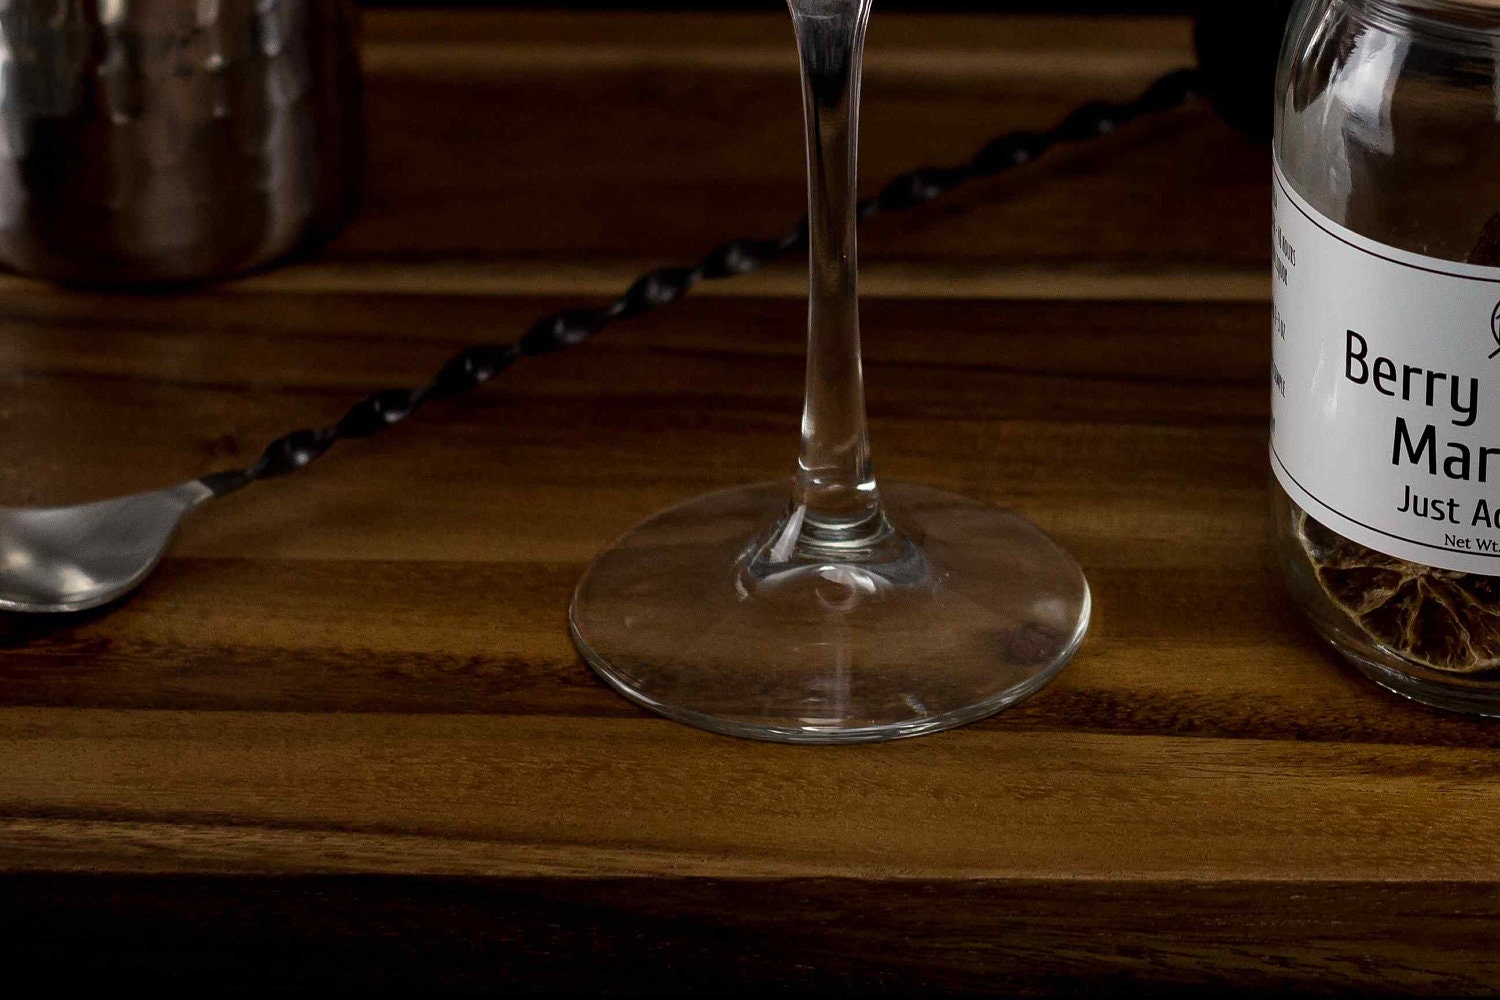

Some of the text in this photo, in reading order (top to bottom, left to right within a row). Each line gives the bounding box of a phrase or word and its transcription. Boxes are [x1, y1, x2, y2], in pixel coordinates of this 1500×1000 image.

[1346, 329, 1479, 427] Berry
[1397, 486, 1460, 525] Just
[1444, 533, 1471, 549] Net
